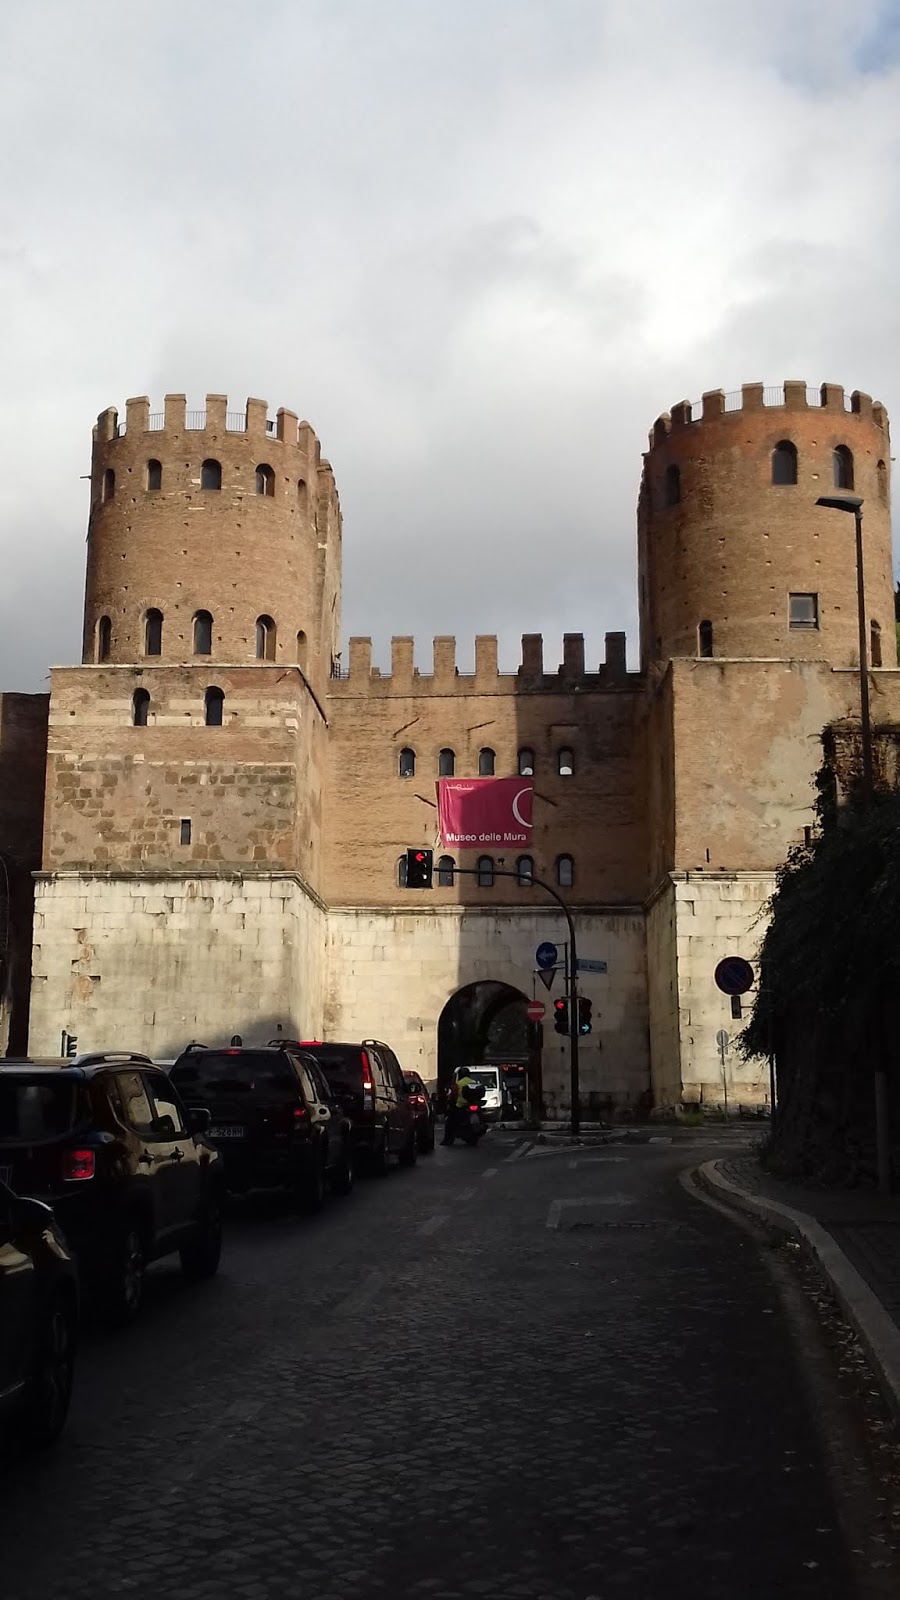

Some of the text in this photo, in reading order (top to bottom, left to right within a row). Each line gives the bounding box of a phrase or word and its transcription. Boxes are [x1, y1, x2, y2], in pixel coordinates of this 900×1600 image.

[446, 832, 527, 842] Museo delle Mura
